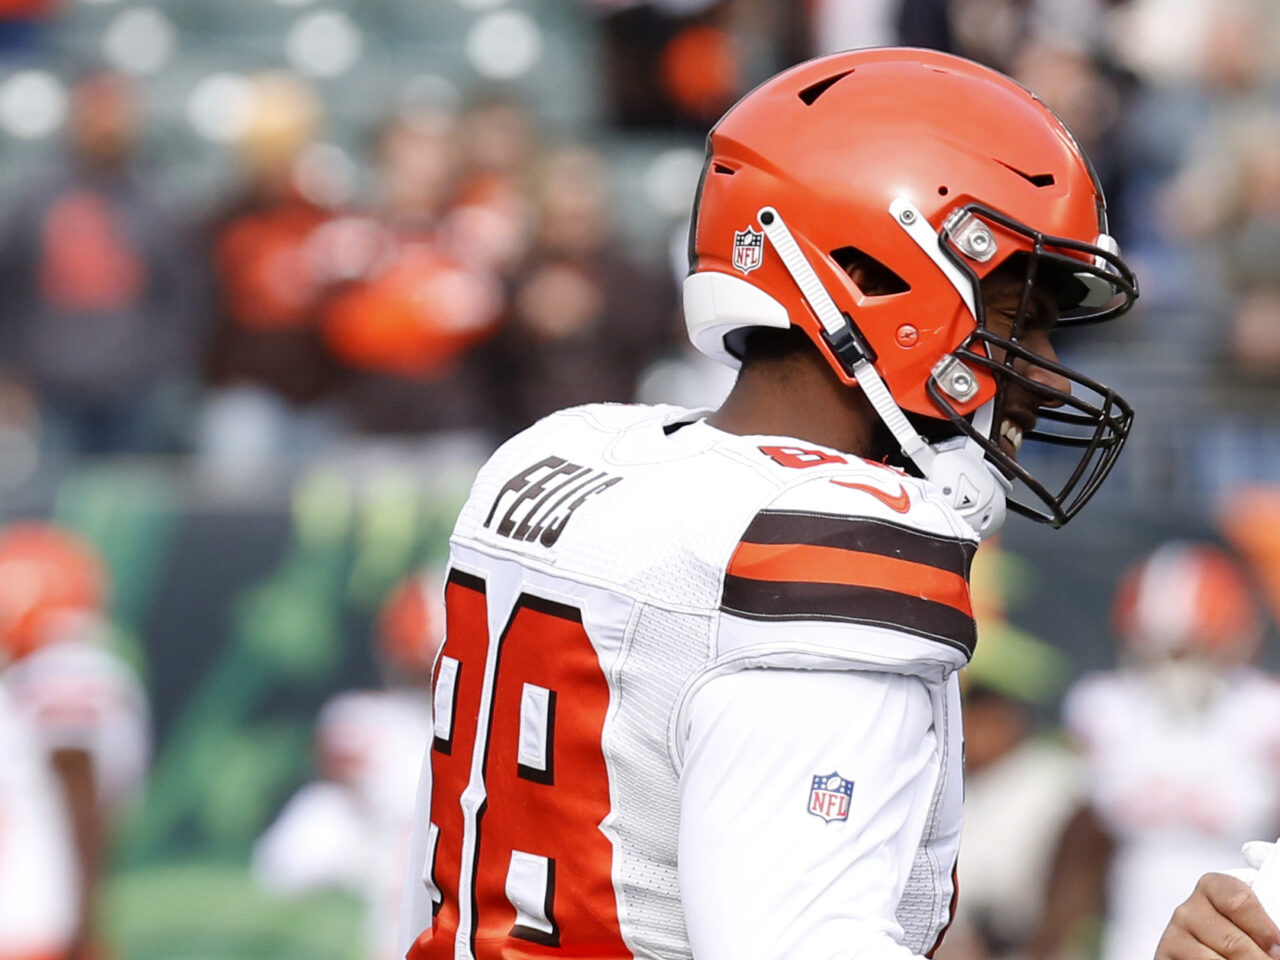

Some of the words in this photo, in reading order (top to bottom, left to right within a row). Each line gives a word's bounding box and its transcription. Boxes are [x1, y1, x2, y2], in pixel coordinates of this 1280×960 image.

[736, 247, 758, 266] NFL
[483, 455, 624, 548] FELLS
[811, 791, 848, 817] NFL
